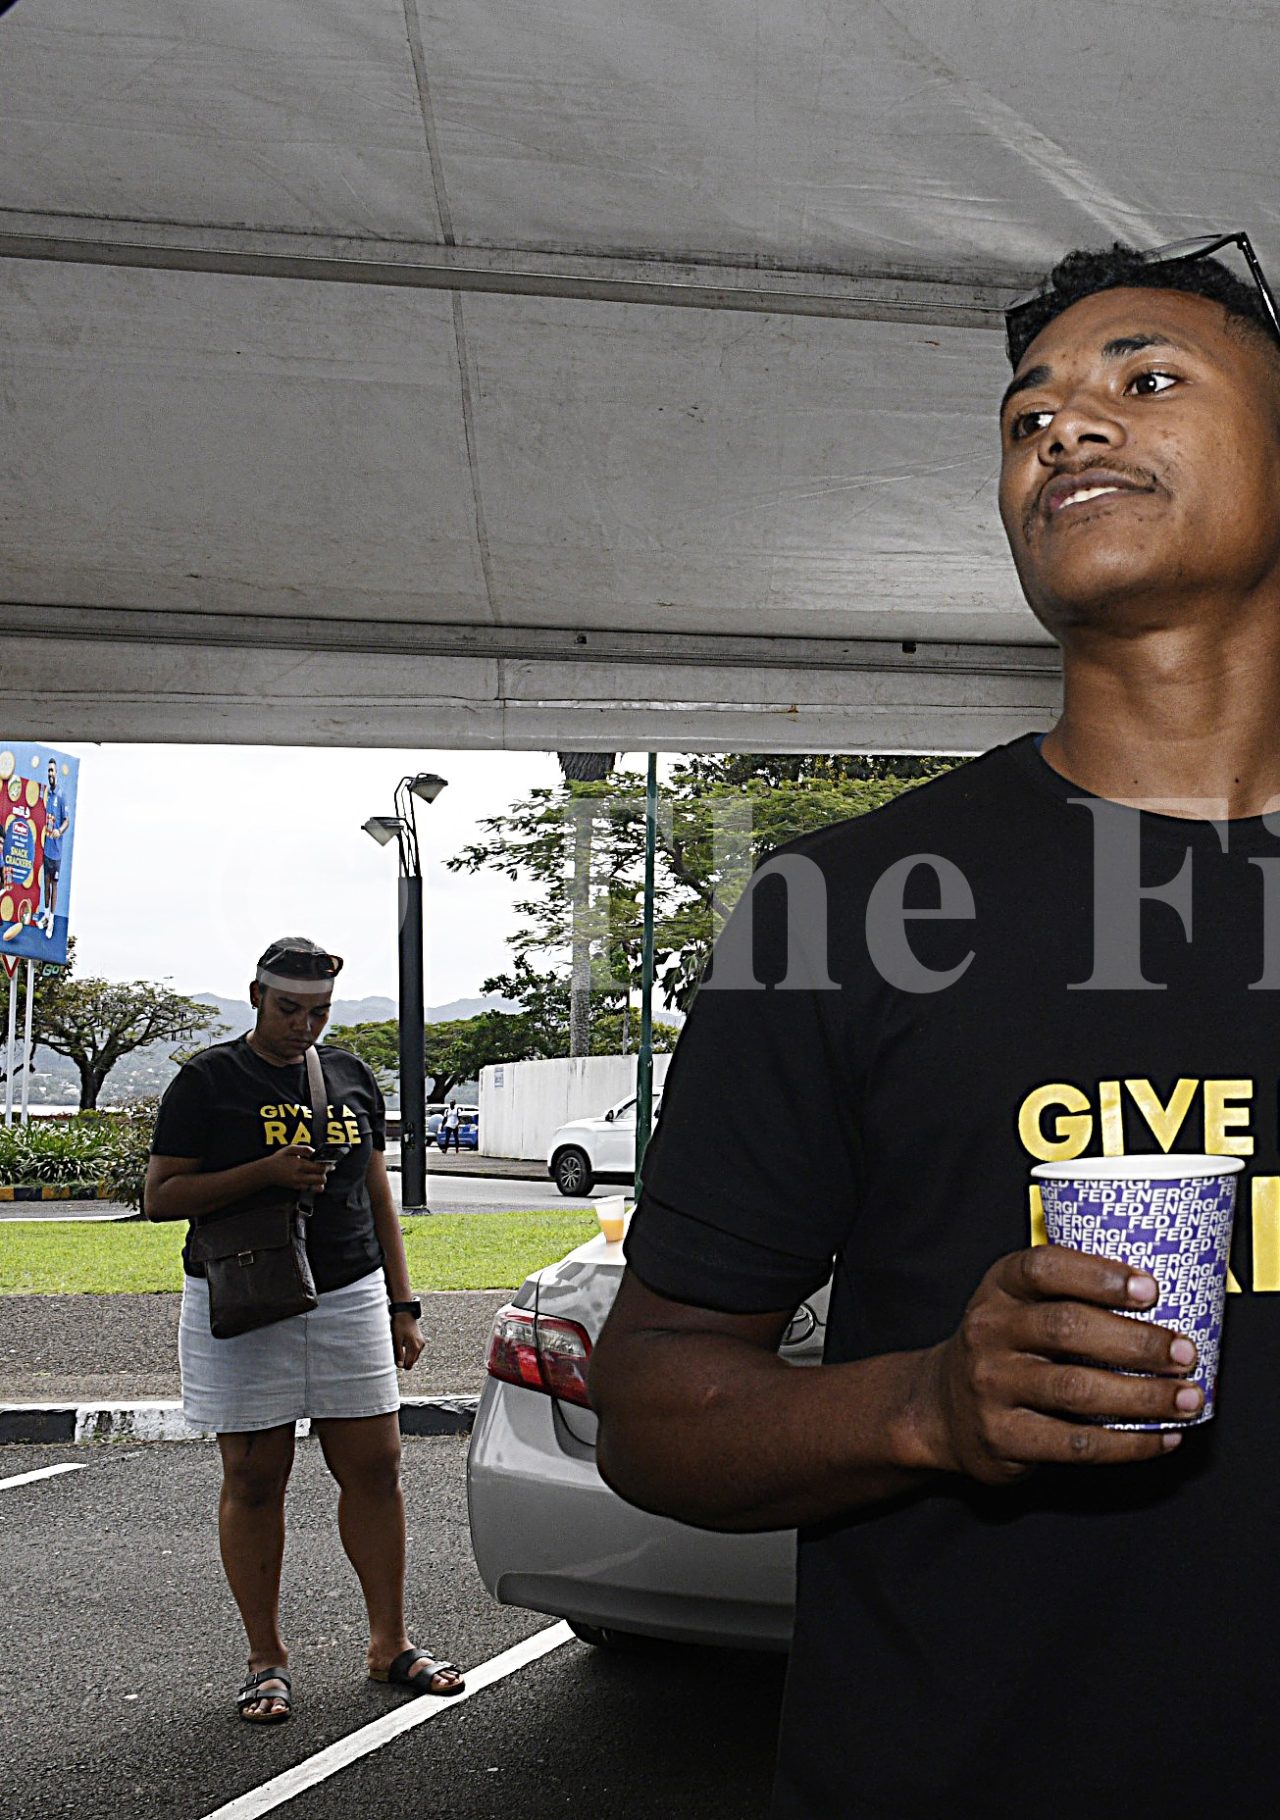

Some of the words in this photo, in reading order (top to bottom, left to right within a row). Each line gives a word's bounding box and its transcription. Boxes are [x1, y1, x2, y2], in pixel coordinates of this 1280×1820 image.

[260, 1103, 313, 1119] GIVE
[342, 1103, 357, 1118] A
[1018, 1078, 1255, 1162] GIVE
[263, 1120, 362, 1145] RASE
[1077, 1188, 1117, 1203] FED
[1102, 1202, 1145, 1217] FED
[1128, 1215, 1171, 1230] FED
[1154, 1226, 1194, 1243] FED
[1178, 1237, 1212, 1254] FED
[1156, 1291, 1193, 1308] FED
[1178, 1302, 1208, 1320] FED
